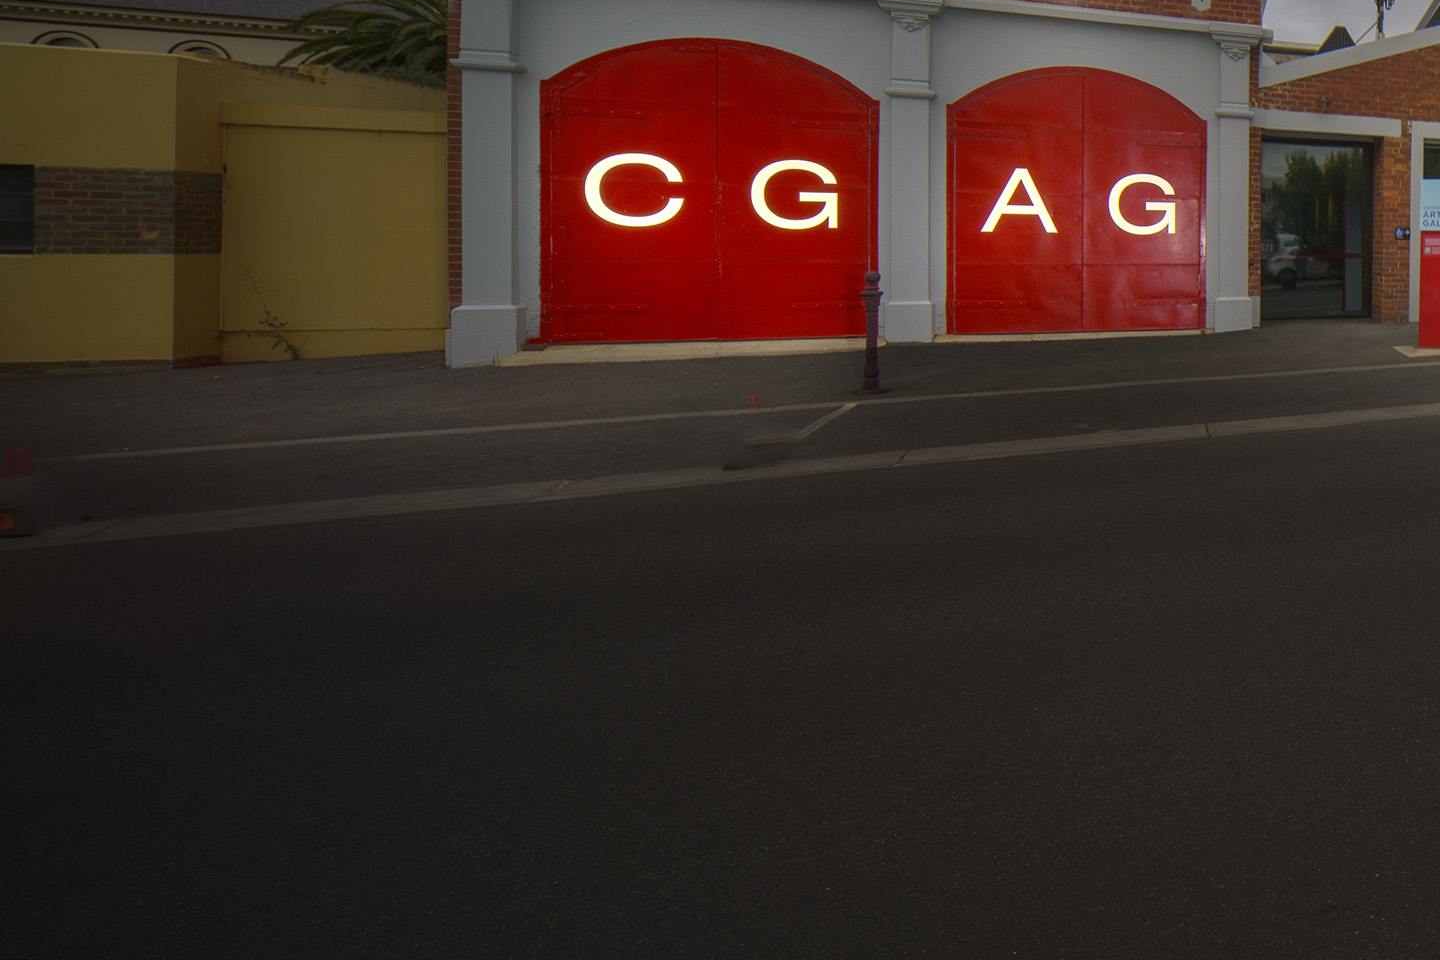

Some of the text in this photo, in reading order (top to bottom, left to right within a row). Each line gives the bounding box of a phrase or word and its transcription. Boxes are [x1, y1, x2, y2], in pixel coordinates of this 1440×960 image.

[584, 152, 1176, 235] C G A G
